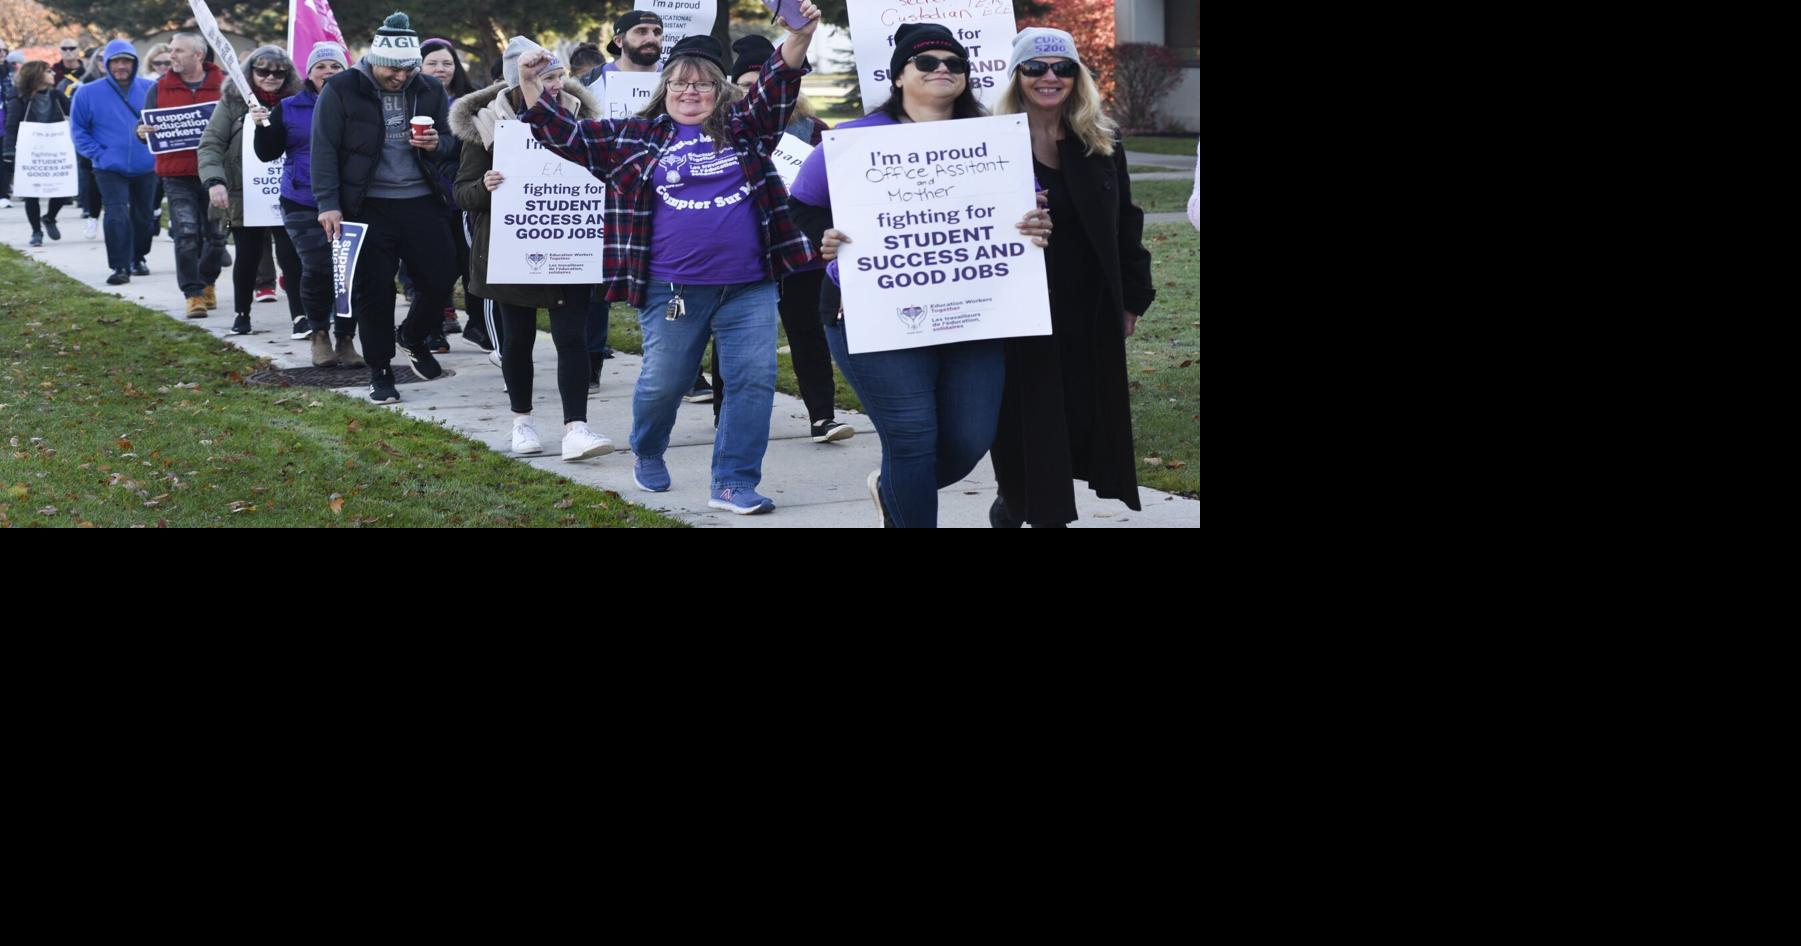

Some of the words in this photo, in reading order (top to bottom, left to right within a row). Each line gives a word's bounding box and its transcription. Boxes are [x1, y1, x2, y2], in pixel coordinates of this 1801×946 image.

[675, 1, 701, 10] proud
[881, 8, 972, 27] Custodian
[957, 28, 982, 41] for
[374, 36, 418, 49] EAGL
[970, 59, 1007, 72] AND
[632, 87, 650, 98] I'm
[156, 110, 202, 123] support
[870, 151, 901, 166] I'm
[908, 152, 919, 164] a
[926, 142, 988, 165] proud
[865, 164, 929, 183] Office
[523, 183, 581, 197] fighting
[585, 183, 604, 195] for
[888, 184, 956, 202] Mother
[656, 185, 712, 210] Compter
[714, 192, 742, 208] Sur
[525, 200, 601, 212] STUDENT
[504, 214, 582, 226] SUCCESS
[585, 214, 605, 226] AN
[876, 207, 960, 229] fighting
[966, 205, 996, 219] for
[516, 228, 564, 240] GOOD
[567, 228, 605, 240] JOBS
[884, 226, 994, 250] STUDENT
[857, 248, 969, 272] SUCCESS
[975, 242, 1025, 261] AND
[877, 270, 946, 290] GOOD
[952, 262, 1009, 282] JOBS
